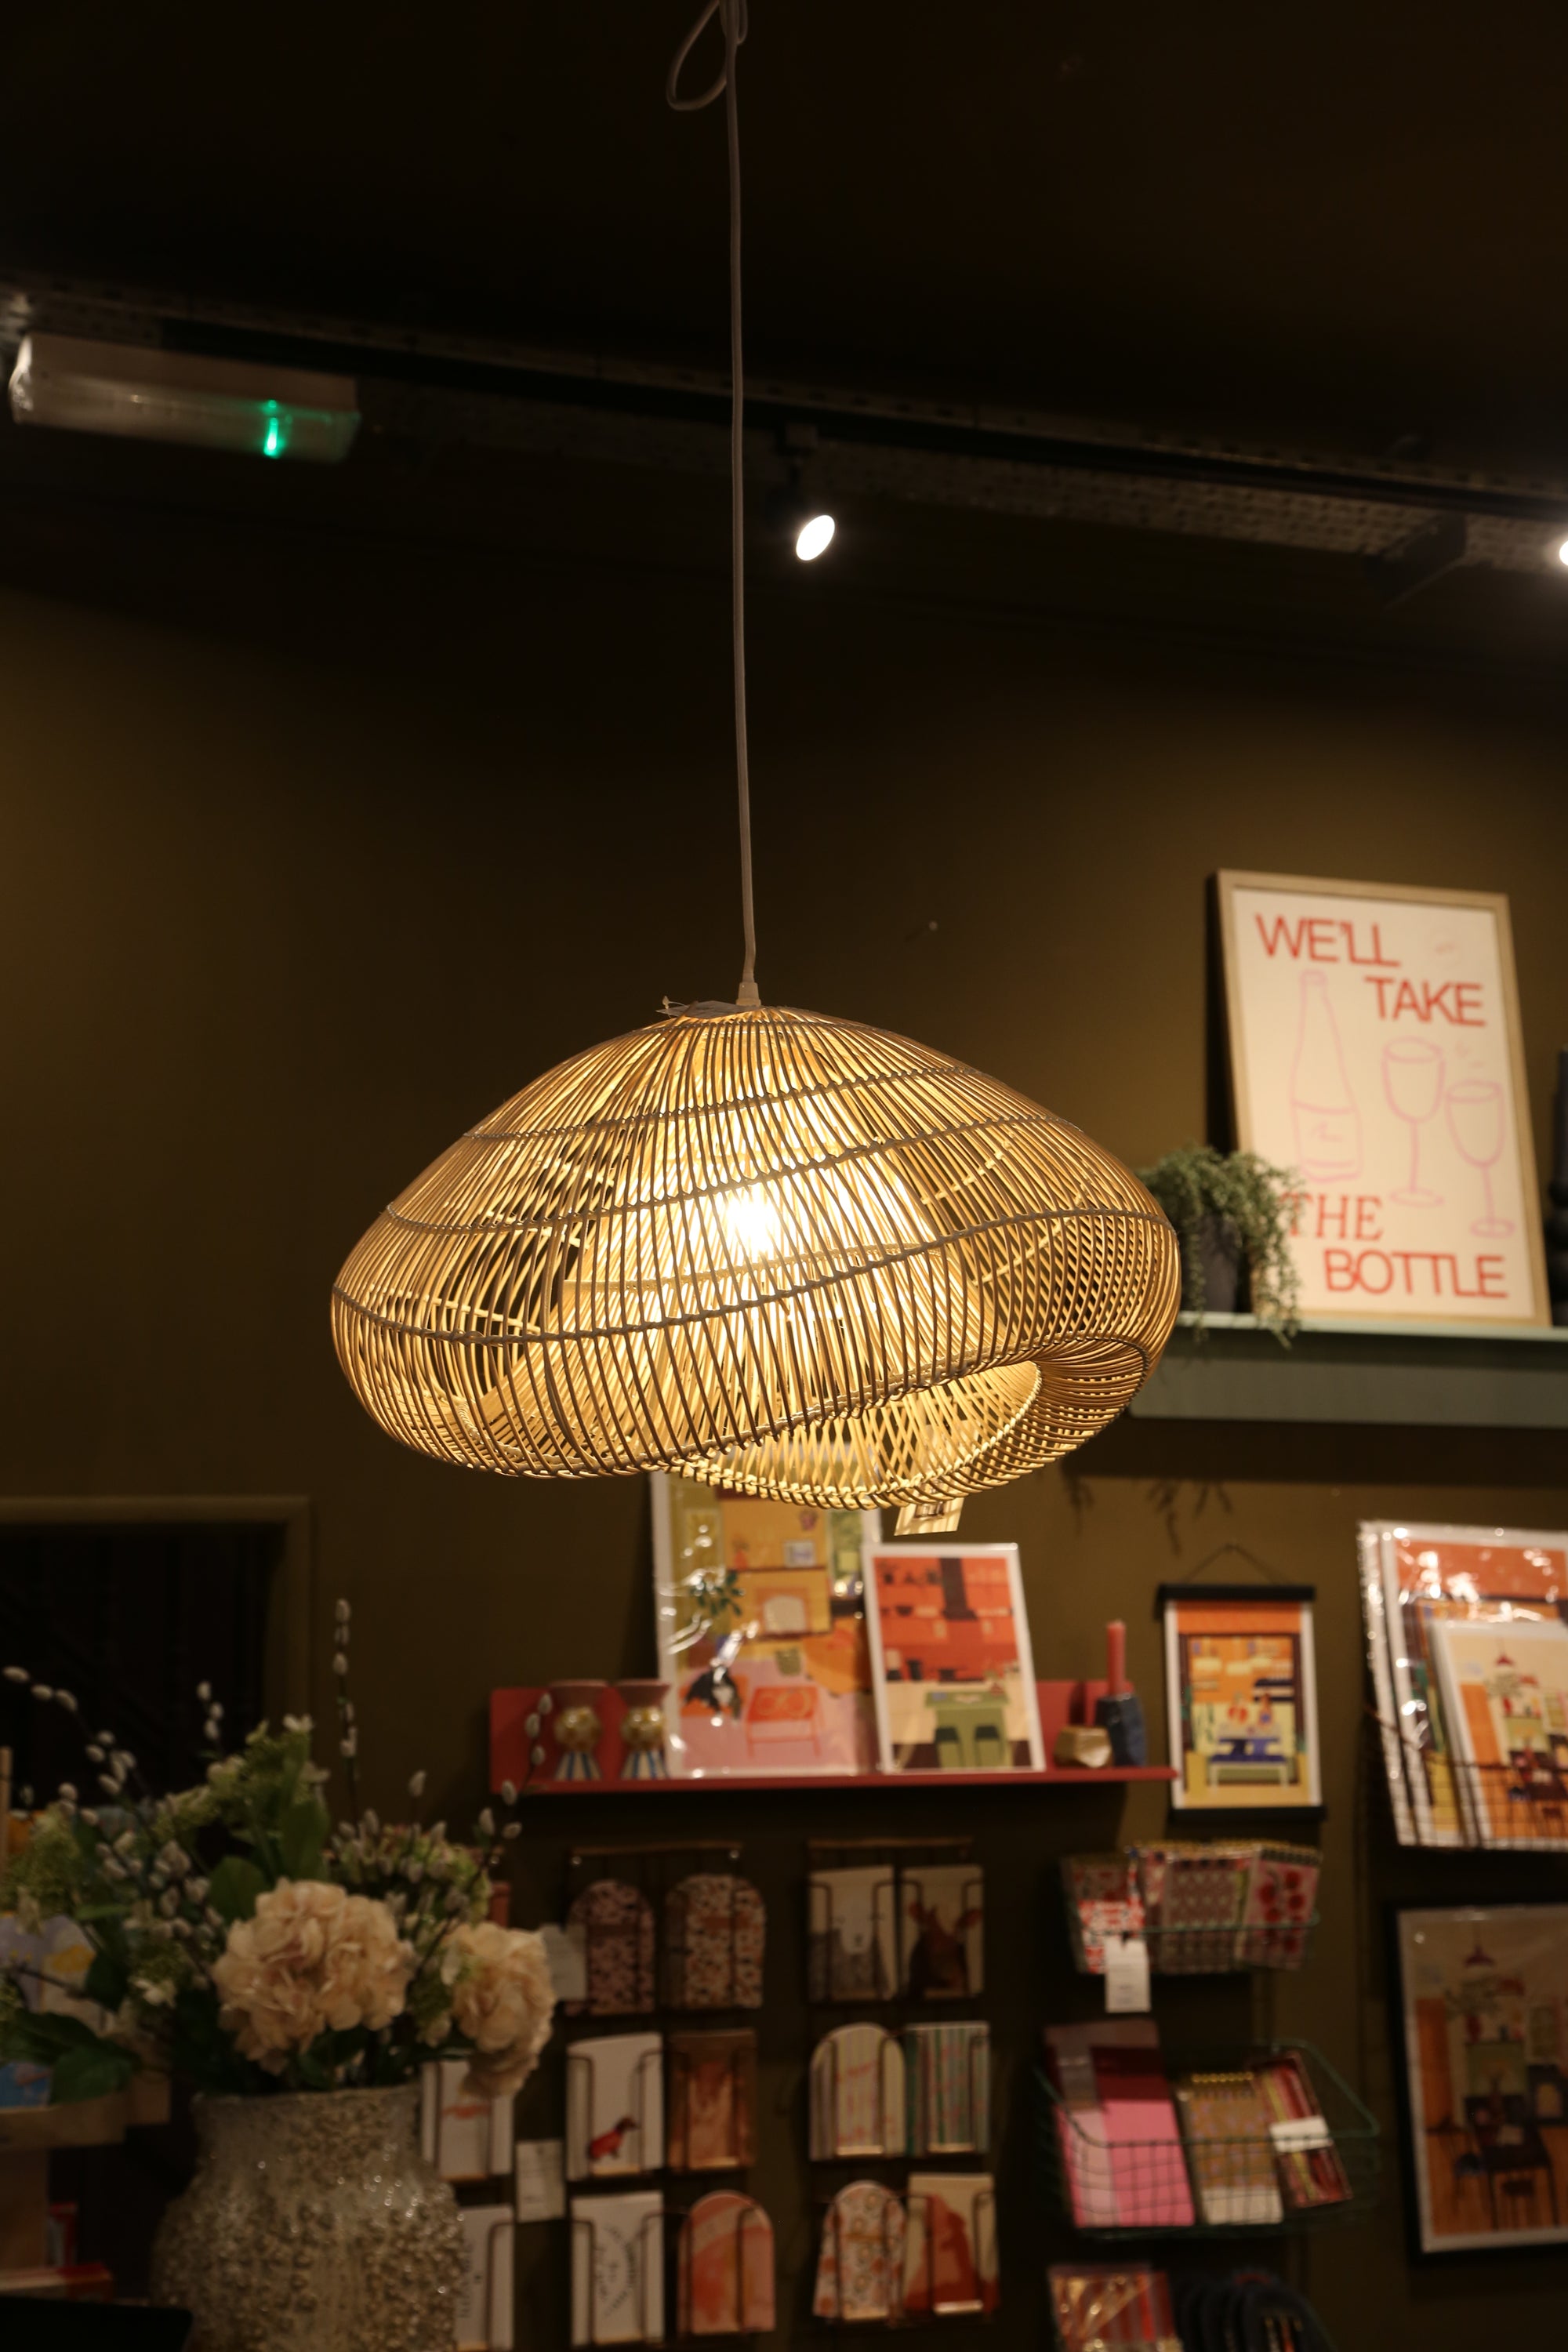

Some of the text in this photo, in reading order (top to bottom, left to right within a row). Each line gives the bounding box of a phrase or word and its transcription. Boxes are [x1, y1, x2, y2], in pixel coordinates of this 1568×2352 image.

[1256, 914, 1399, 967] WE'LL
[1364, 976, 1485, 1027] TAKE
[1279, 1191, 1383, 1241] THE
[1324, 1249, 1507, 1298] BOTTLE
